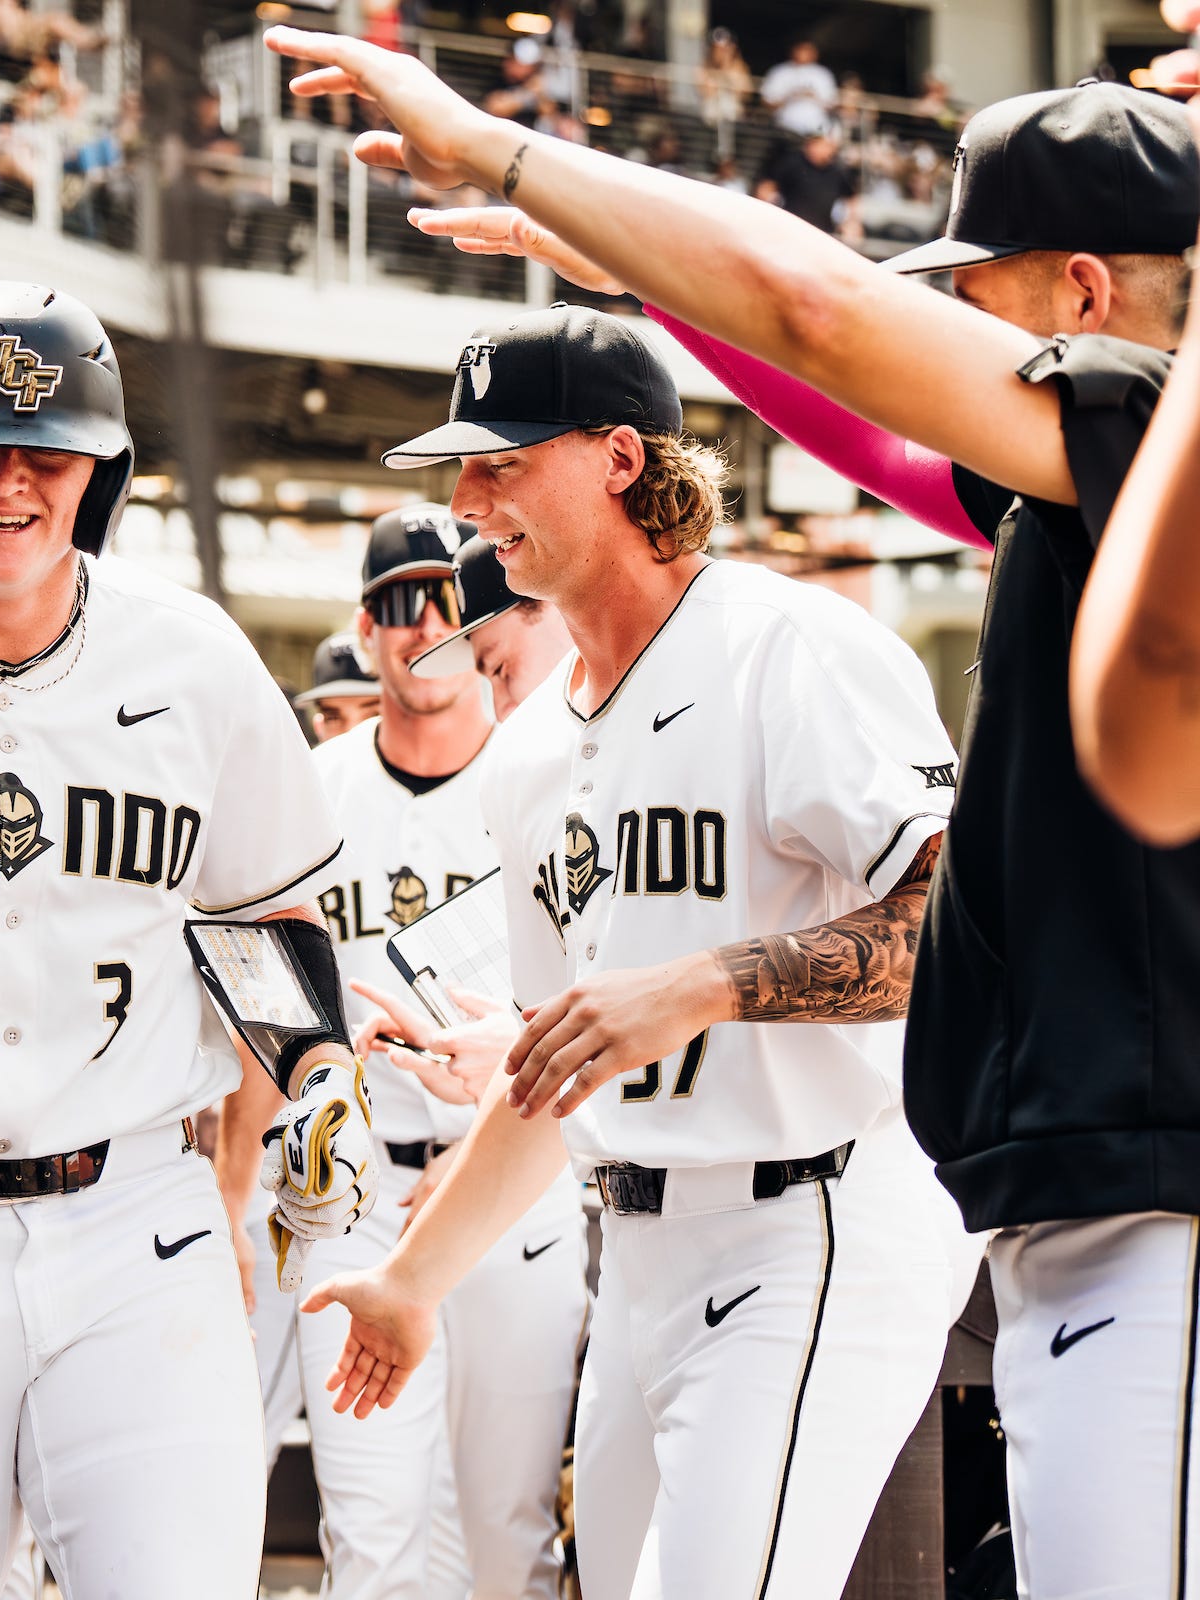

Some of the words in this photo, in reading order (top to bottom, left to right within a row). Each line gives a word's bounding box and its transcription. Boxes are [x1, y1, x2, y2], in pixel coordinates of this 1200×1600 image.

[456, 344, 497, 371] CF
[910, 762, 956, 789] XII
[61, 783, 202, 893] NDO
[316, 880, 386, 944] RL
[82, 959, 134, 1070] 3
